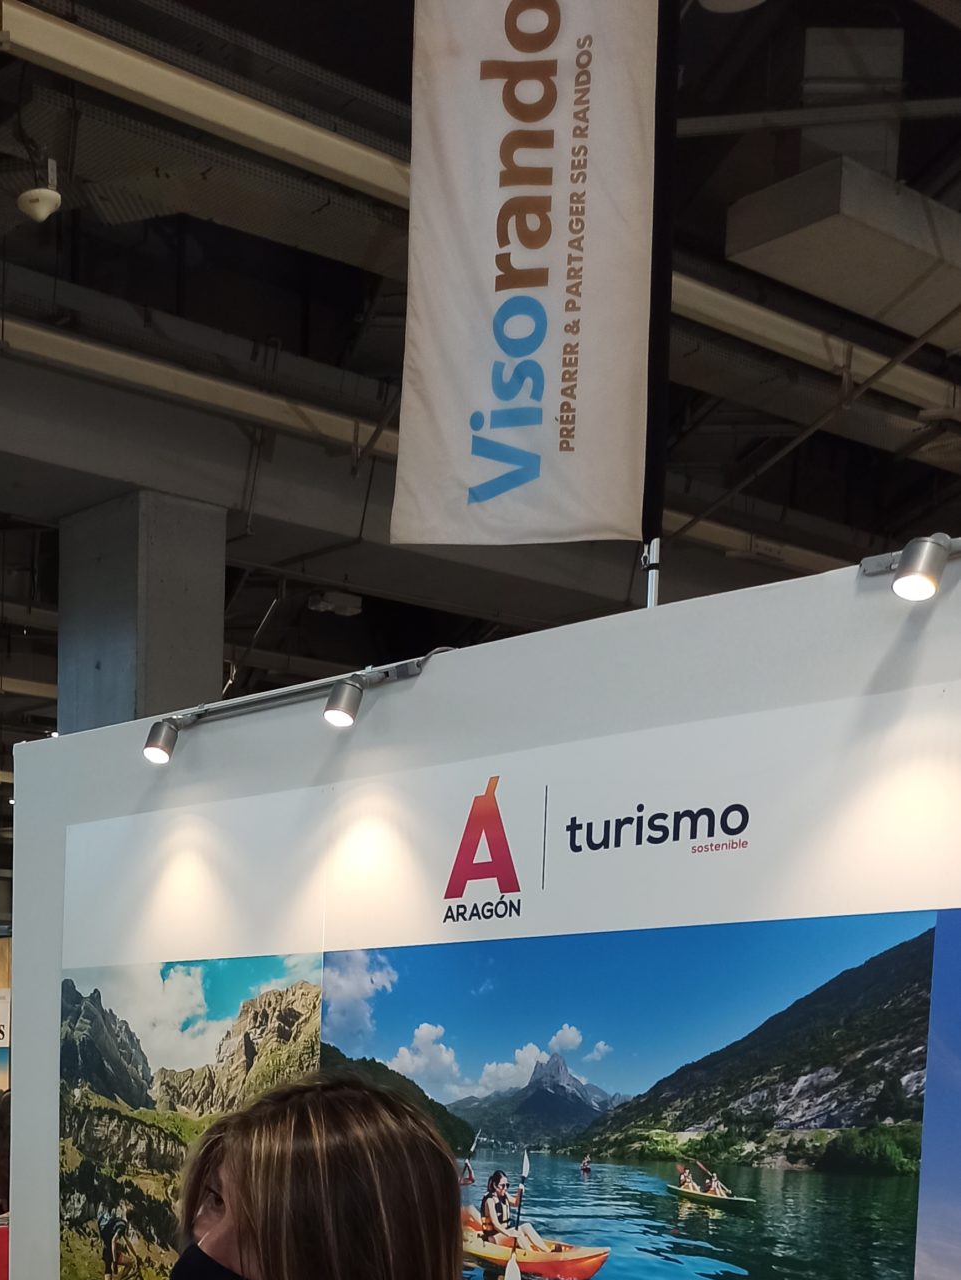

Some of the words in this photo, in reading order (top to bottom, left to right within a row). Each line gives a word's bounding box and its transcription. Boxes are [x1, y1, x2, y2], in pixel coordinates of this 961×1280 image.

[572, 34, 593, 140] RANDOS
[570, 143, 588, 183] SES
[467, 0, 560, 505] Visorando
[565, 192, 586, 313] PARTAGER
[555, 342, 580, 453] PRÉPARER
[566, 803, 750, 852] turismo
[691, 838, 748, 854] sostenible
[443, 894, 521, 923] ARAGÓN
